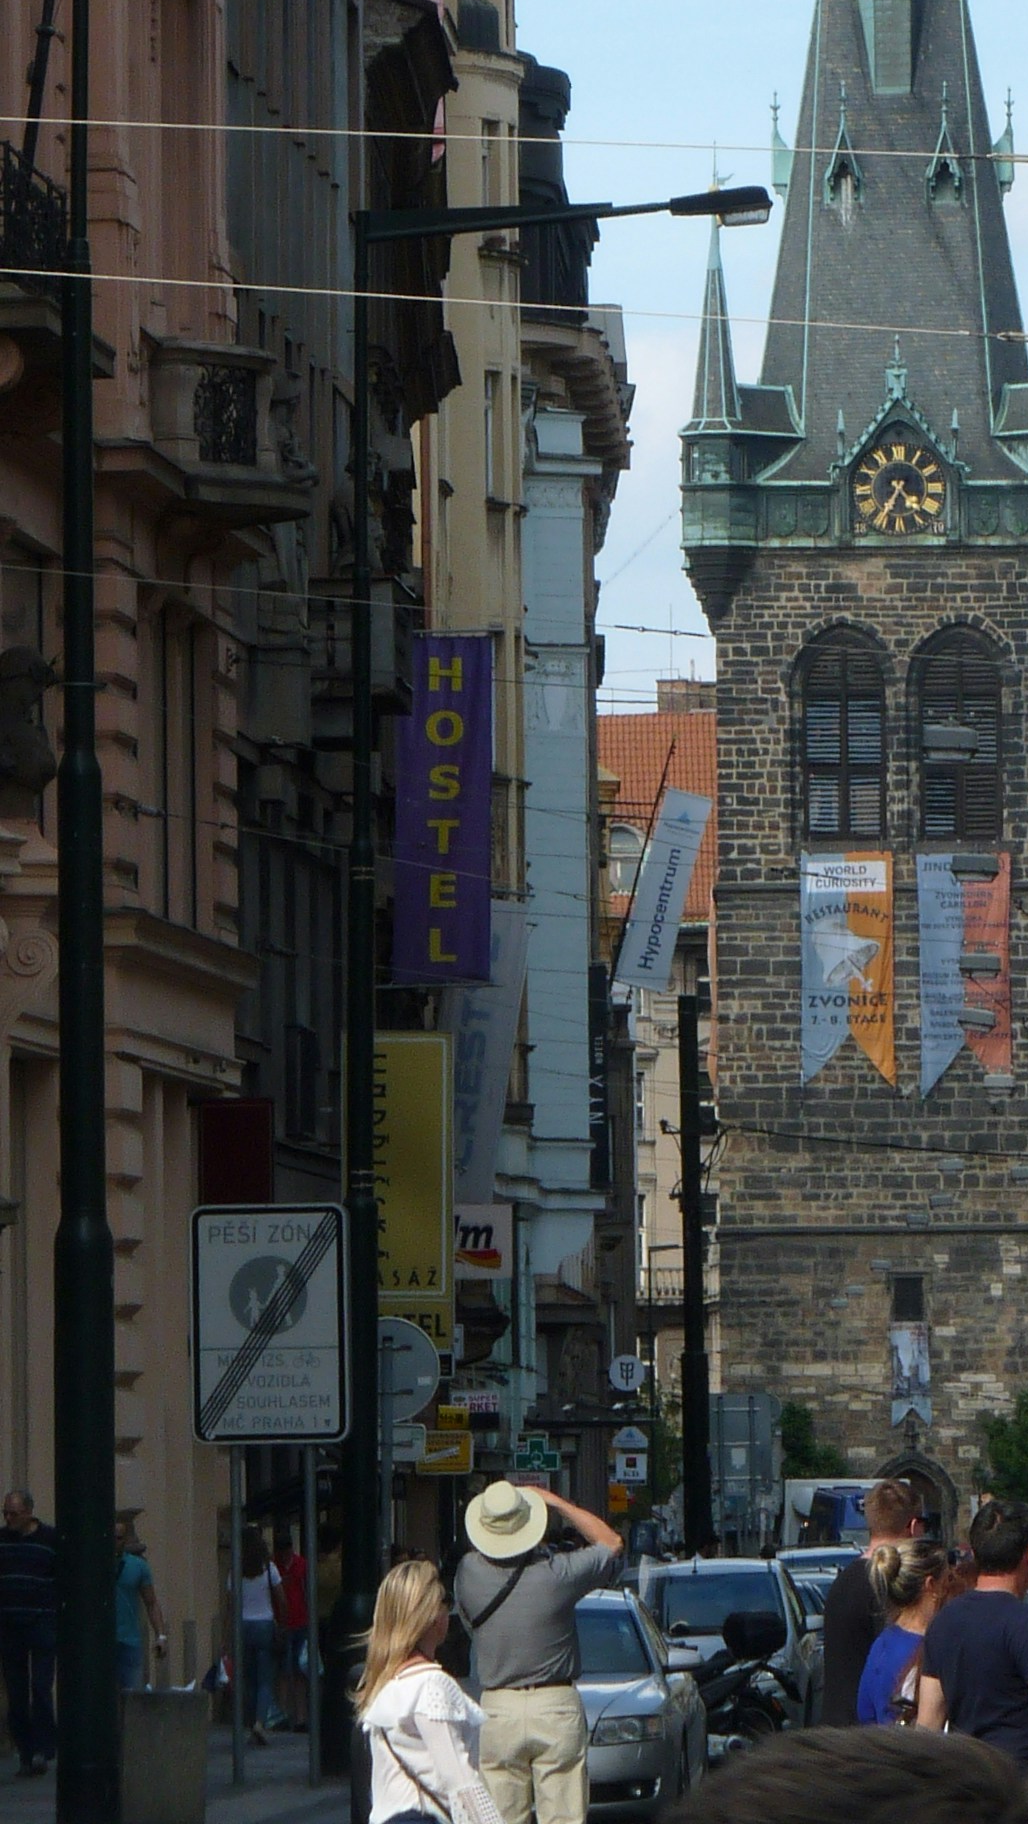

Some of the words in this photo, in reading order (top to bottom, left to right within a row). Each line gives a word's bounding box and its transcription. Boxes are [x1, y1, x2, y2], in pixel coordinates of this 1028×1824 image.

[425, 656, 464, 963] HOSTEL
[824, 865, 867, 876] WORLD
[815, 877, 877, 888] CURIOSITY
[637, 847, 682, 972] Hypocentrum
[804, 902, 890, 925] RESTAURANT
[808, 993, 888, 1009] ZVONICE
[208, 1220, 257, 1244] PĚŠÍ
[247, 1373, 311, 1388] VOZIDLA
[236, 1394, 331, 1409] SOUHLASEM
[223, 1415, 244, 1430] MČ
[252, 1416, 304, 1430] PRAHA
